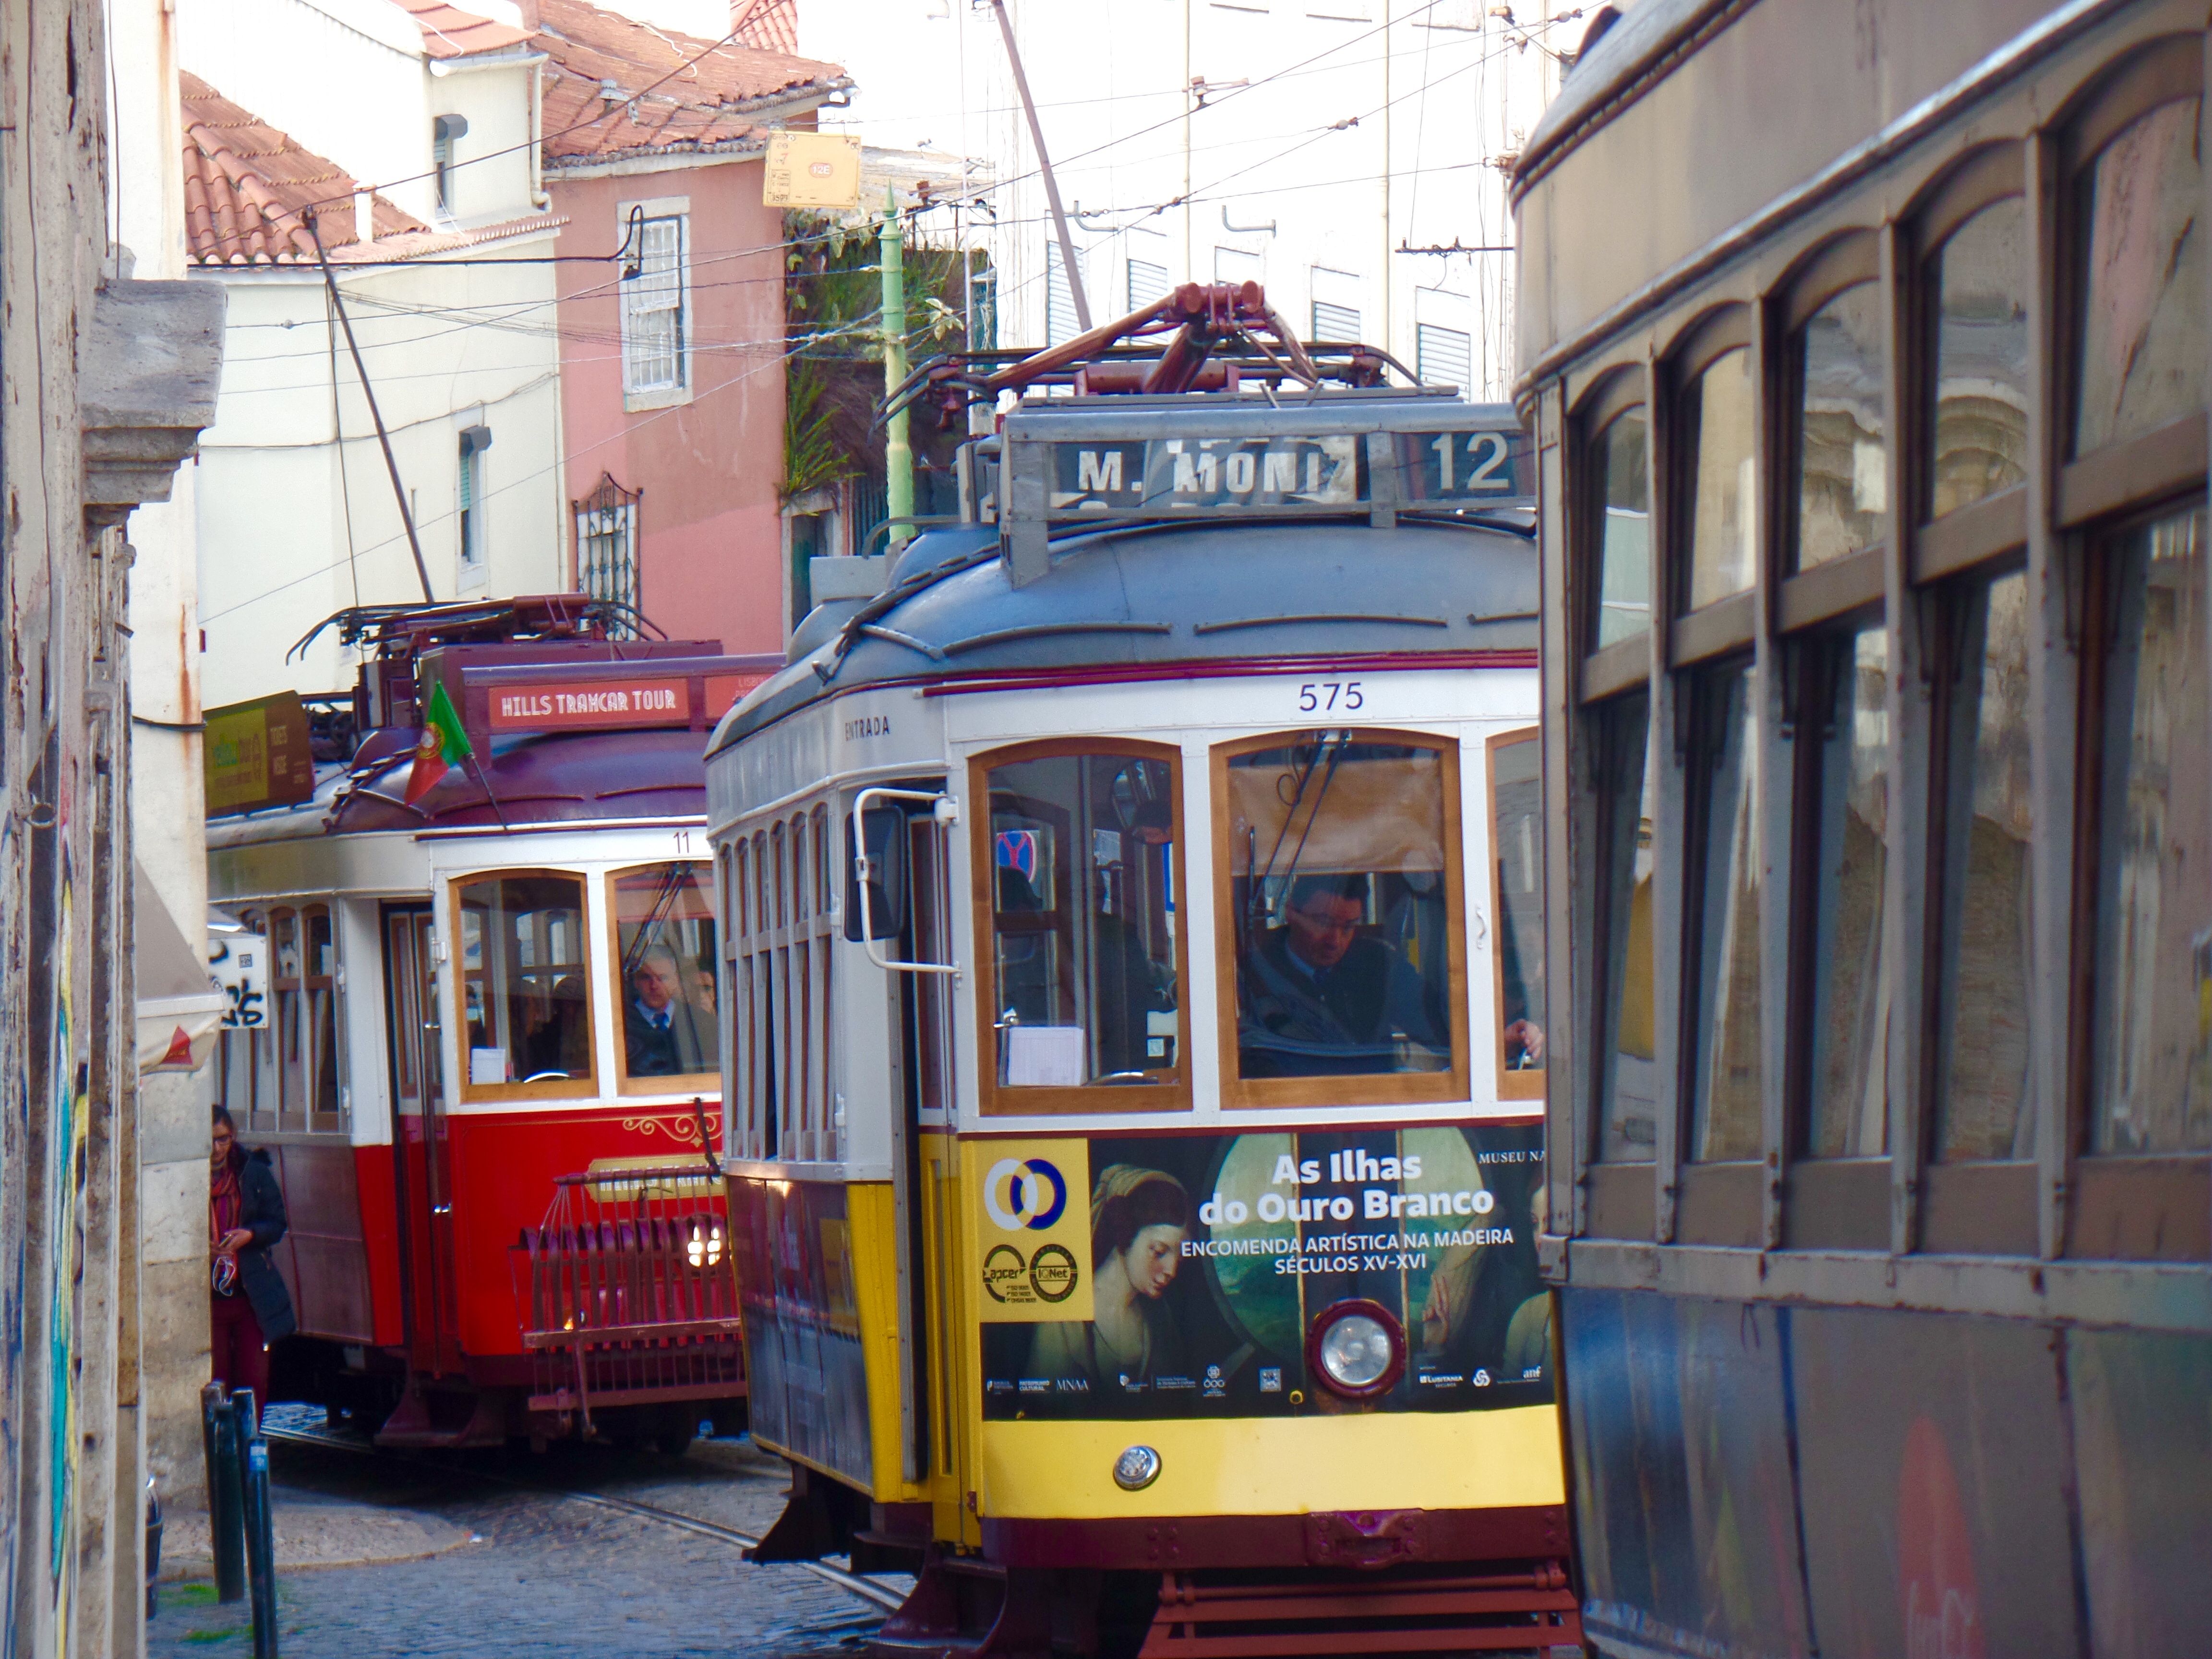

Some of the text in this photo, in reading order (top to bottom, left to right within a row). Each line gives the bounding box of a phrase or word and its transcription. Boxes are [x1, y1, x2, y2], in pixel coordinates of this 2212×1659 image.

[812, 165, 830, 175] 12E
[1078, 450, 1142, 492] M.
[1431, 432, 1510, 490] 12
[501, 689, 676, 717] HILLS TRAMCAR TOUR
[1298, 682, 1364, 712] 575
[844, 715, 890, 742] ENTRADA
[673, 831, 690, 854] 11
[1272, 1148, 1422, 1184] As Ilhas
[1479, 1151, 1526, 1164] MUSEU
[1199, 1189, 1494, 1225] do Ouro Branco
[1181, 1228, 1514, 1257] ENCOMENDA ARTÍSTICA NA MADEIRA
[990, 1268, 1018, 1283] apcer
[1274, 1253, 1427, 1275] SÉCULOS XV-XVI
